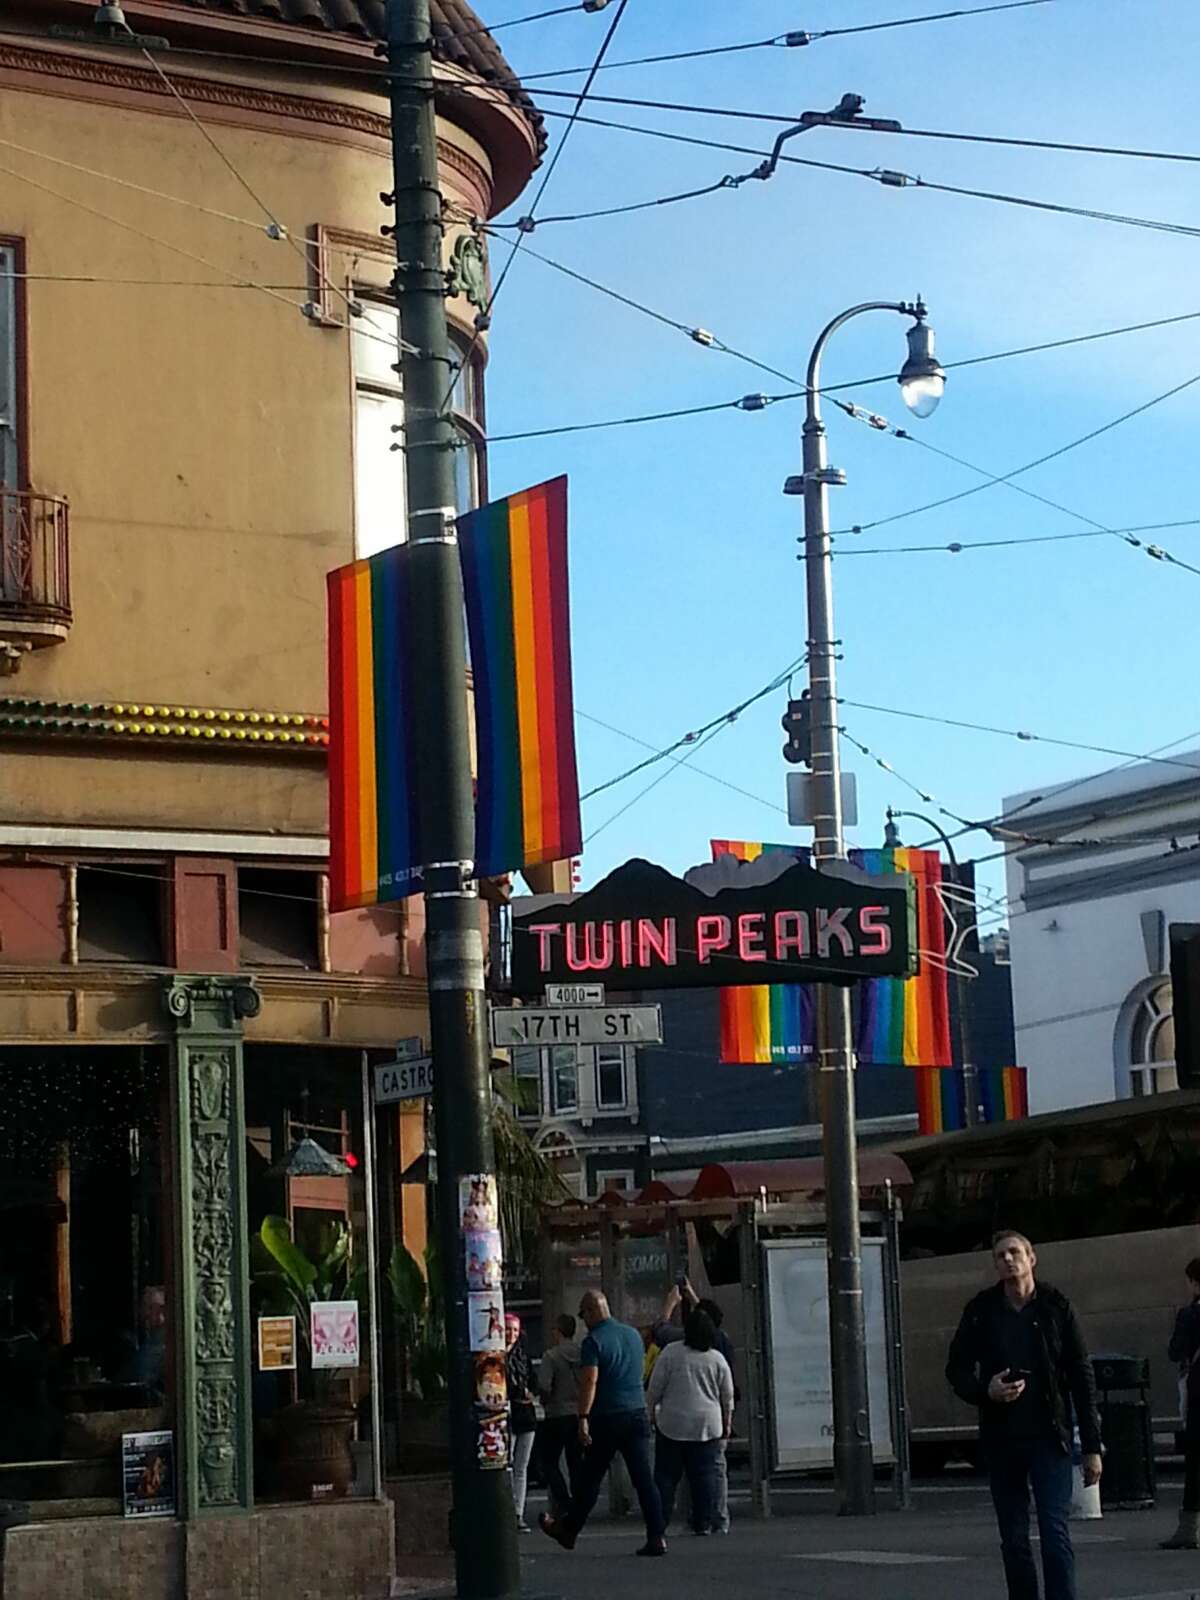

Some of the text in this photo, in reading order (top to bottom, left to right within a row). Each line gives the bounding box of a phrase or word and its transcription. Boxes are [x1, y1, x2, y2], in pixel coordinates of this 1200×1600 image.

[529, 905, 891, 972] TWIN PEAKS
[556, 988, 585, 1001] 4000
[522, 1014, 632, 1038] 17TH ST
[382, 1064, 435, 1094] CASTRO
